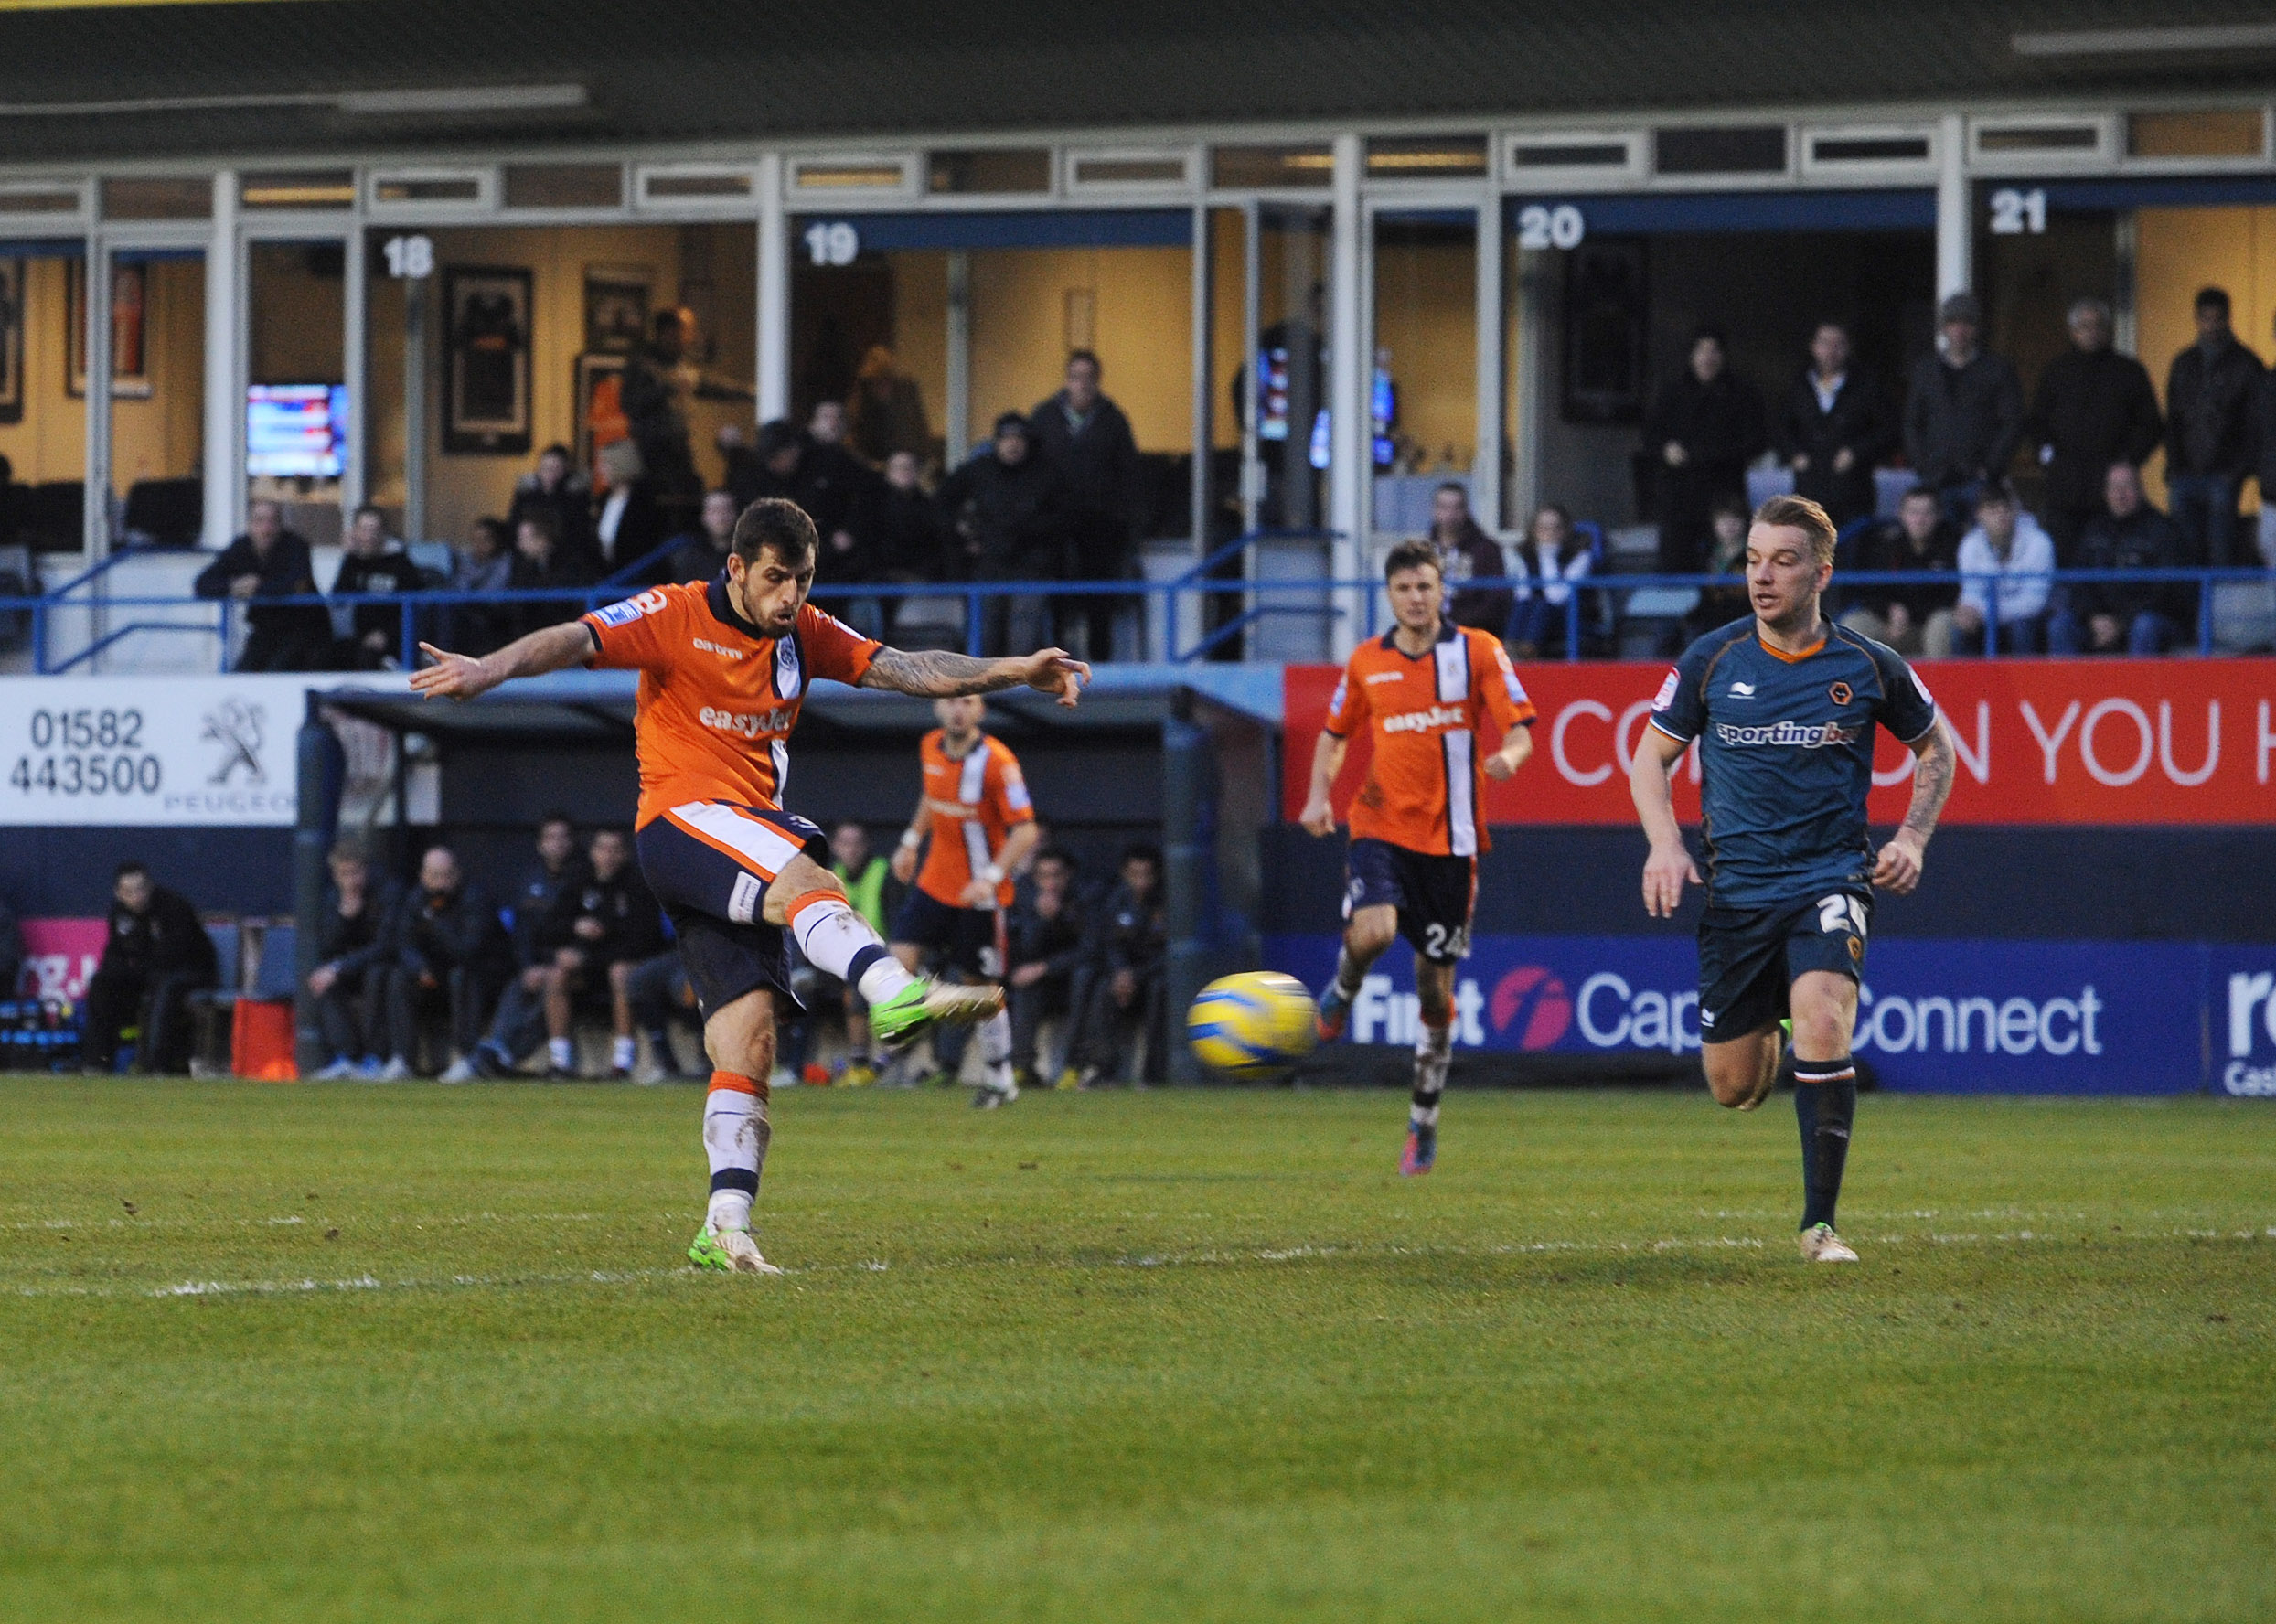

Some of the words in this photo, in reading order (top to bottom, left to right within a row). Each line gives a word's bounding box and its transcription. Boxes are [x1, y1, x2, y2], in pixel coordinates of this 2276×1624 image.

[1517, 206, 1585, 250] 20
[1990, 189, 2047, 233] 21
[383, 234, 433, 278] 18
[805, 222, 859, 267] 19
[31, 709, 144, 749] 01582
[2019, 697, 2221, 787] YOU
[10, 753, 161, 795] 443500
[163, 793, 297, 814] PEUGEO
[1426, 923, 1470, 958] 24
